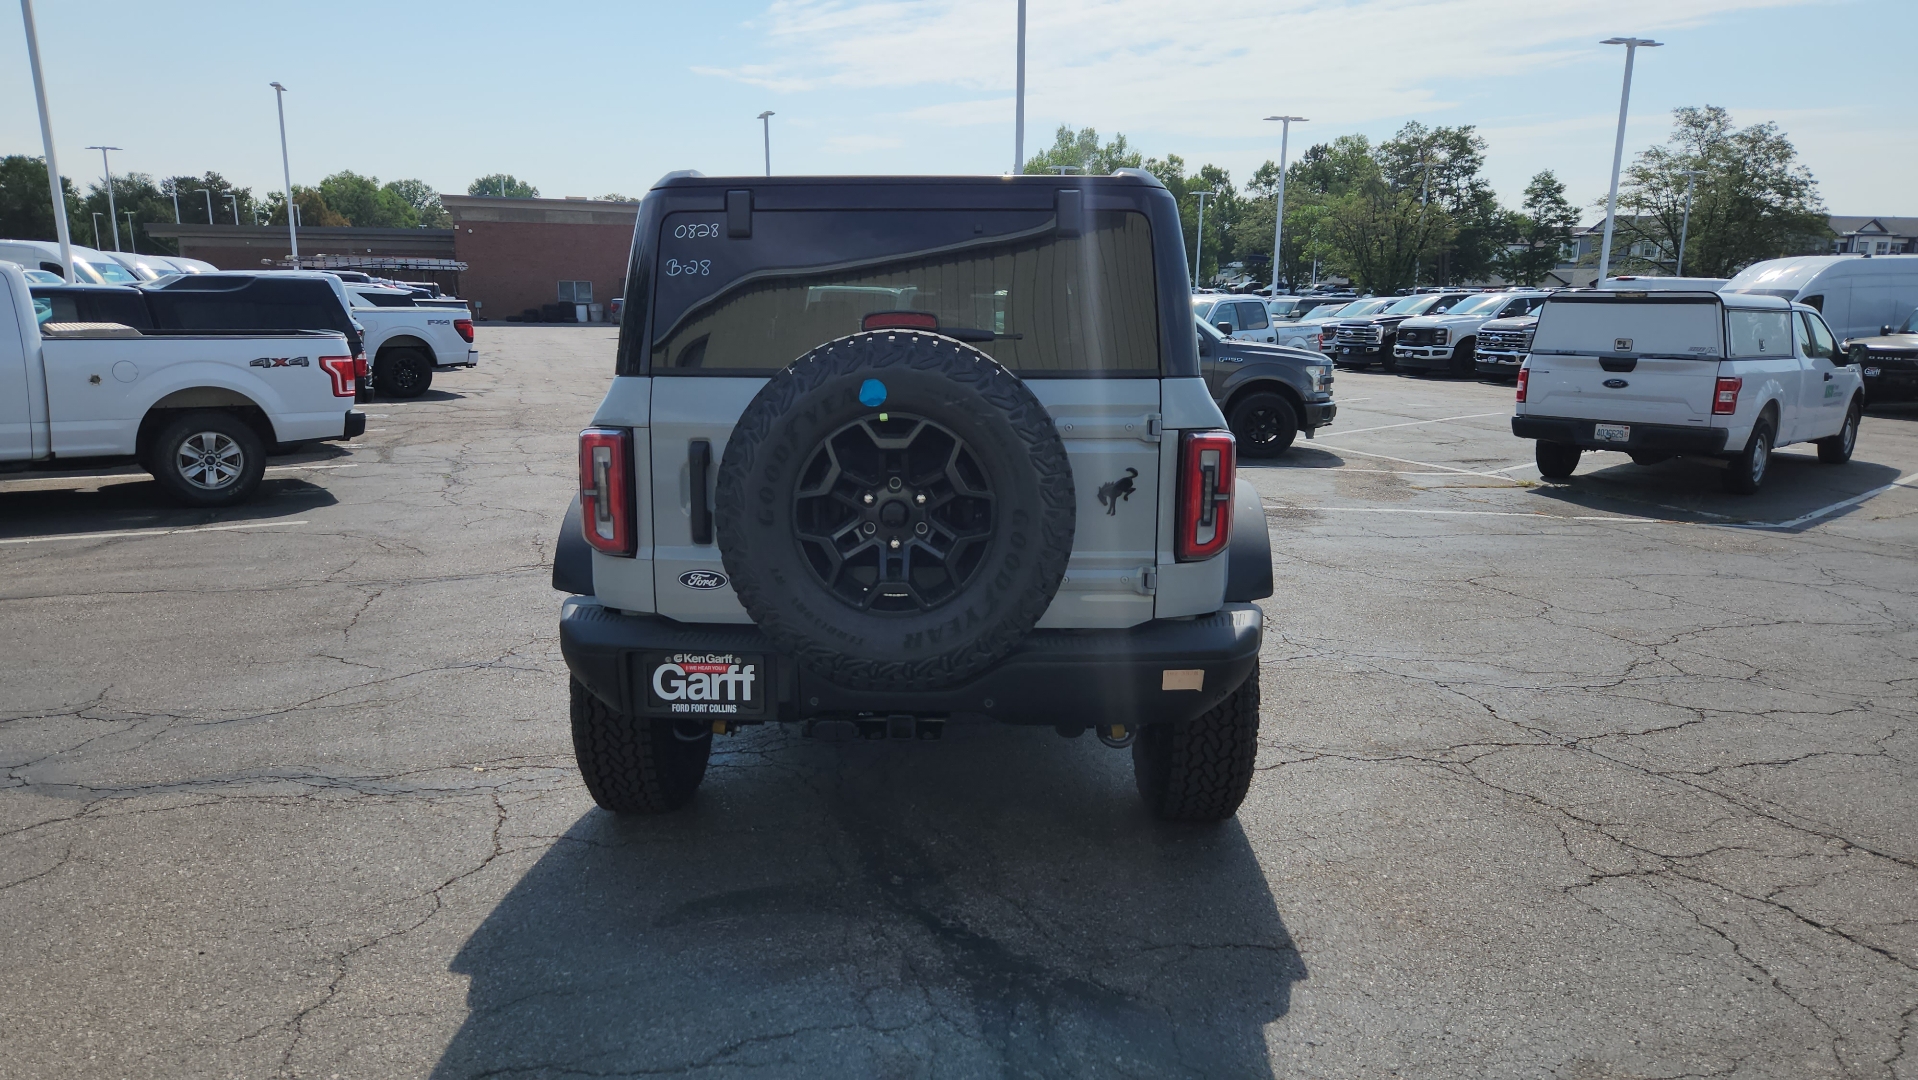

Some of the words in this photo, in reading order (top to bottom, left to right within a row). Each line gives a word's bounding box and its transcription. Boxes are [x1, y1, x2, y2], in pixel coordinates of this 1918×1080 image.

[674, 223, 719, 239] 0828
[665, 258, 712, 277] B-28
[687, 573, 718, 587] Ford
[683, 653, 705, 663] Ken
[706, 653, 733, 664] Garff
[652, 663, 755, 701] Garff
[671, 703, 689, 712] FORD
[691, 704, 708, 713] FORT
[709, 704, 737, 713] COLLINS
